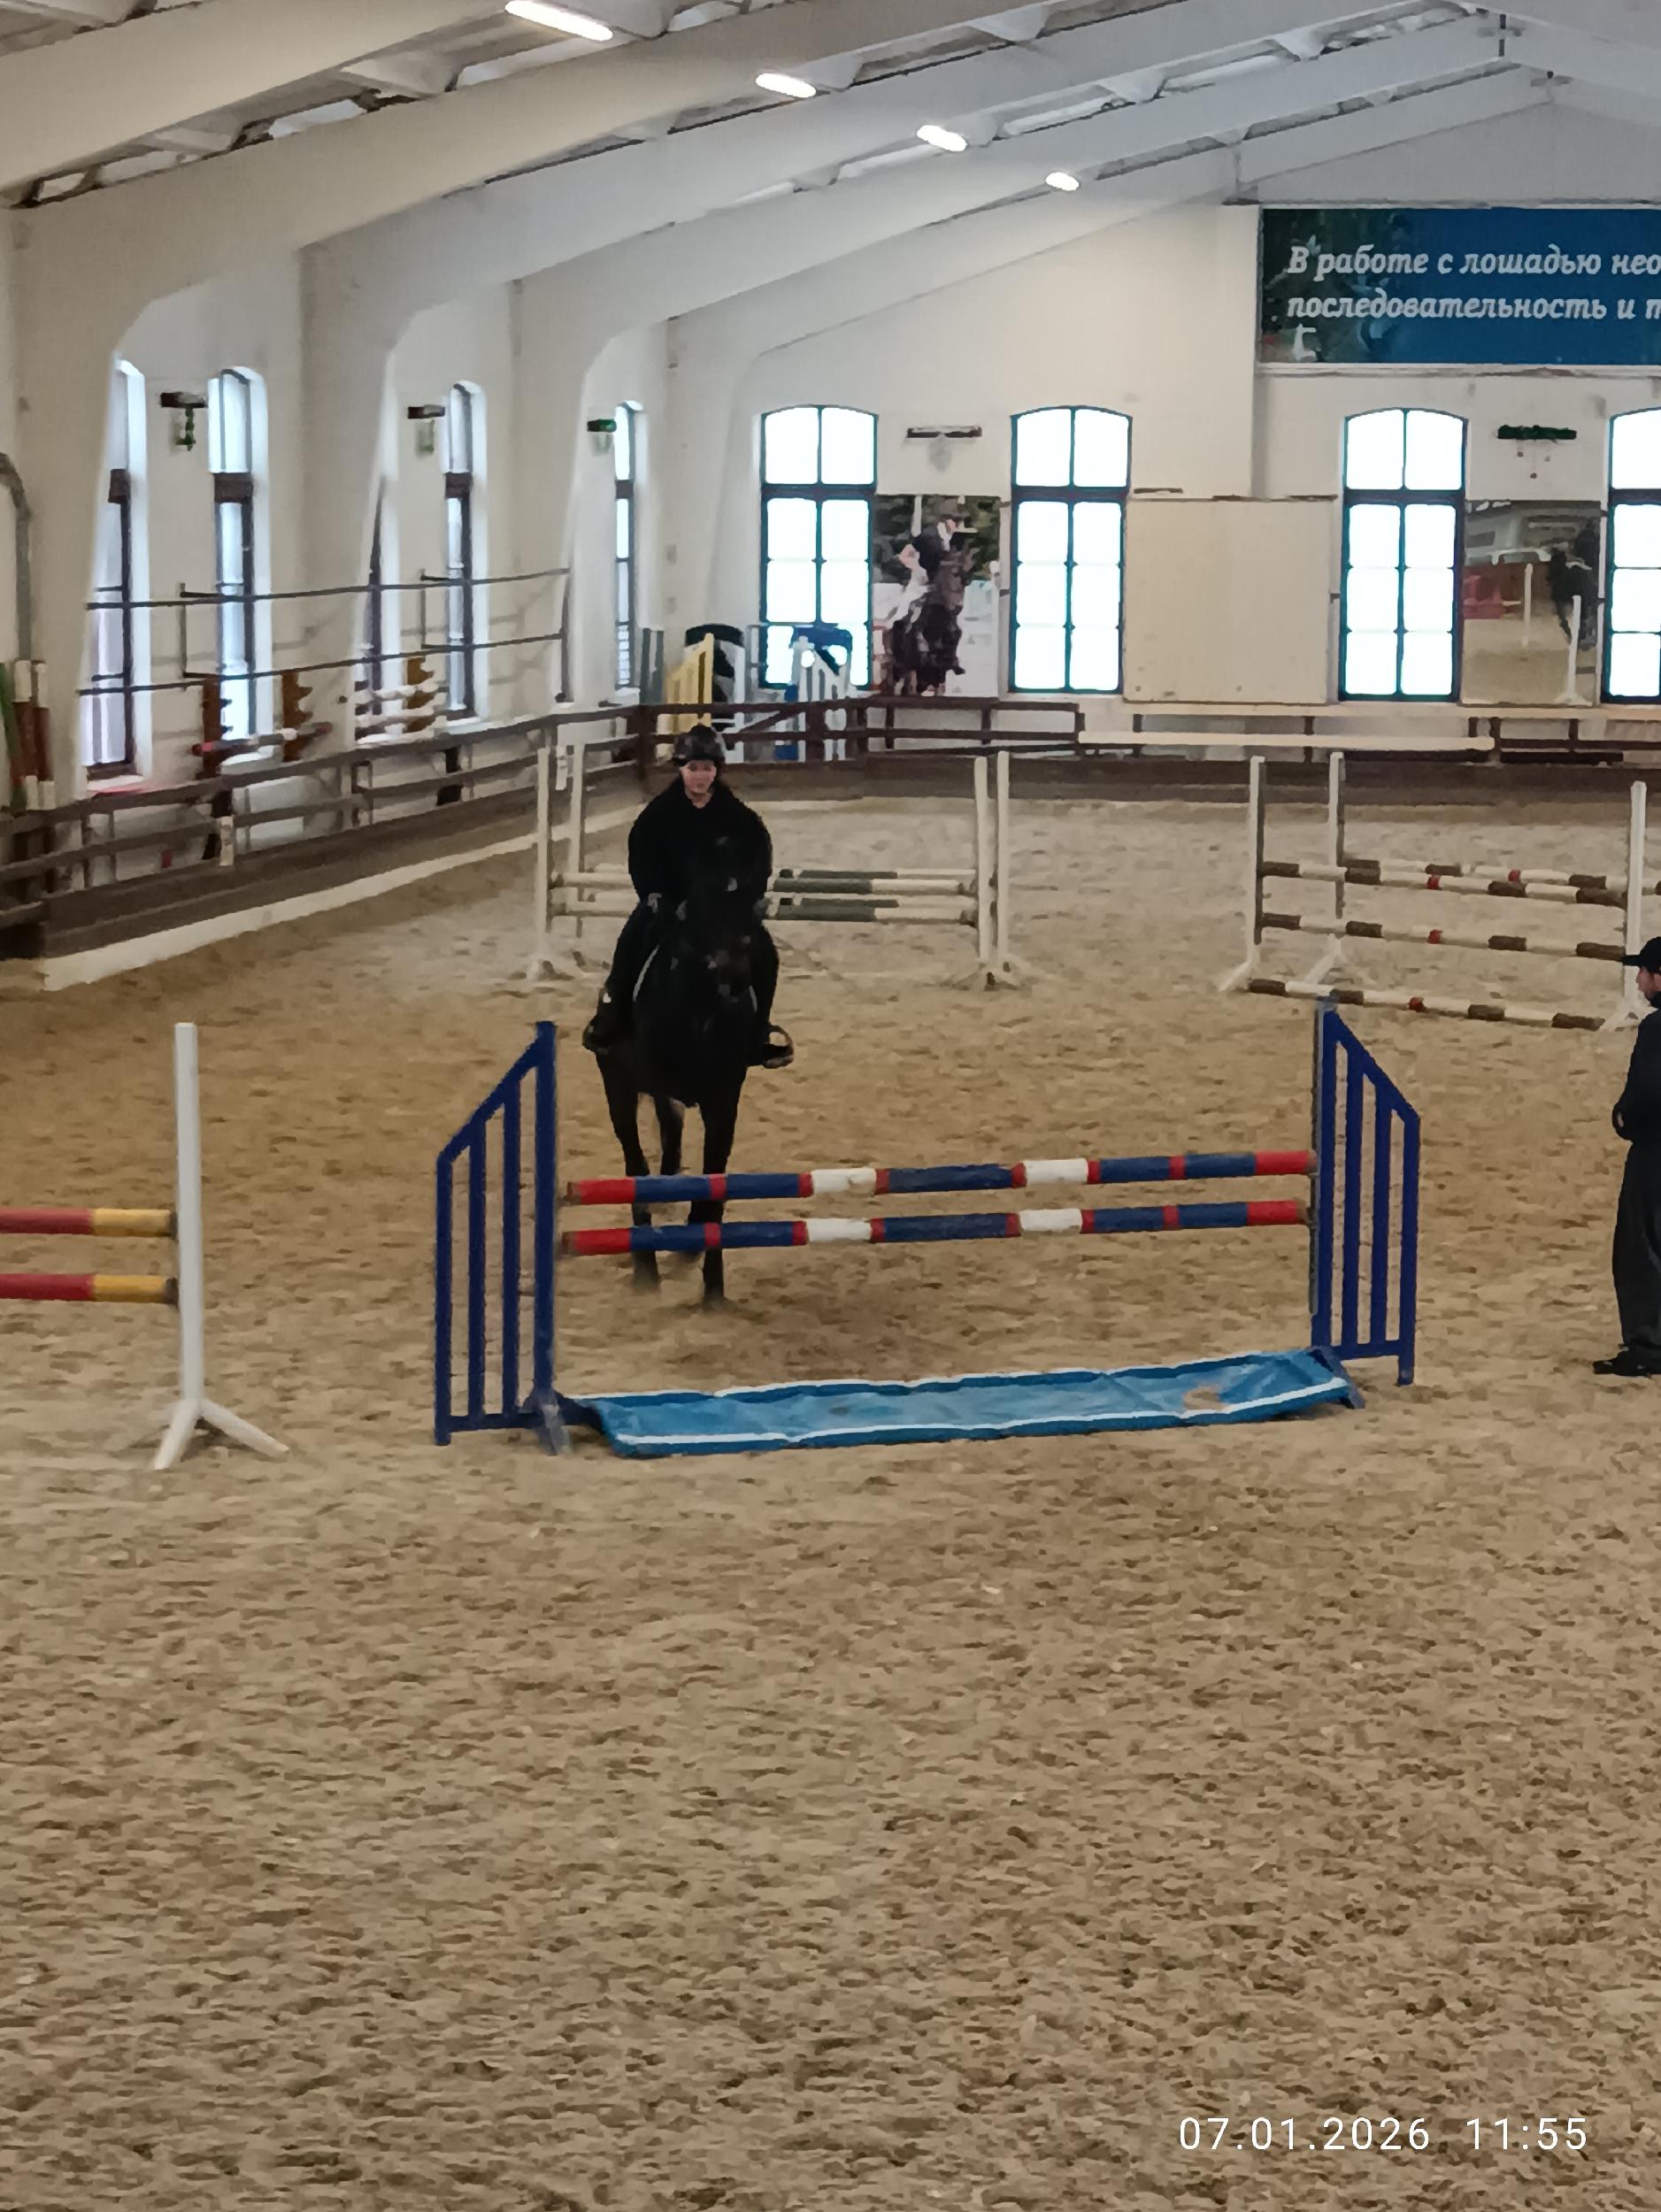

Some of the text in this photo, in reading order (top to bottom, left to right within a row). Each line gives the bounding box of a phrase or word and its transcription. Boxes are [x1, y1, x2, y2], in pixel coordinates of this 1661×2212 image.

[1287, 243, 1661, 282] В работе с лошадью нео
[1287, 287, 1607, 319] последовательность
[1618, 298, 1636, 319] и
